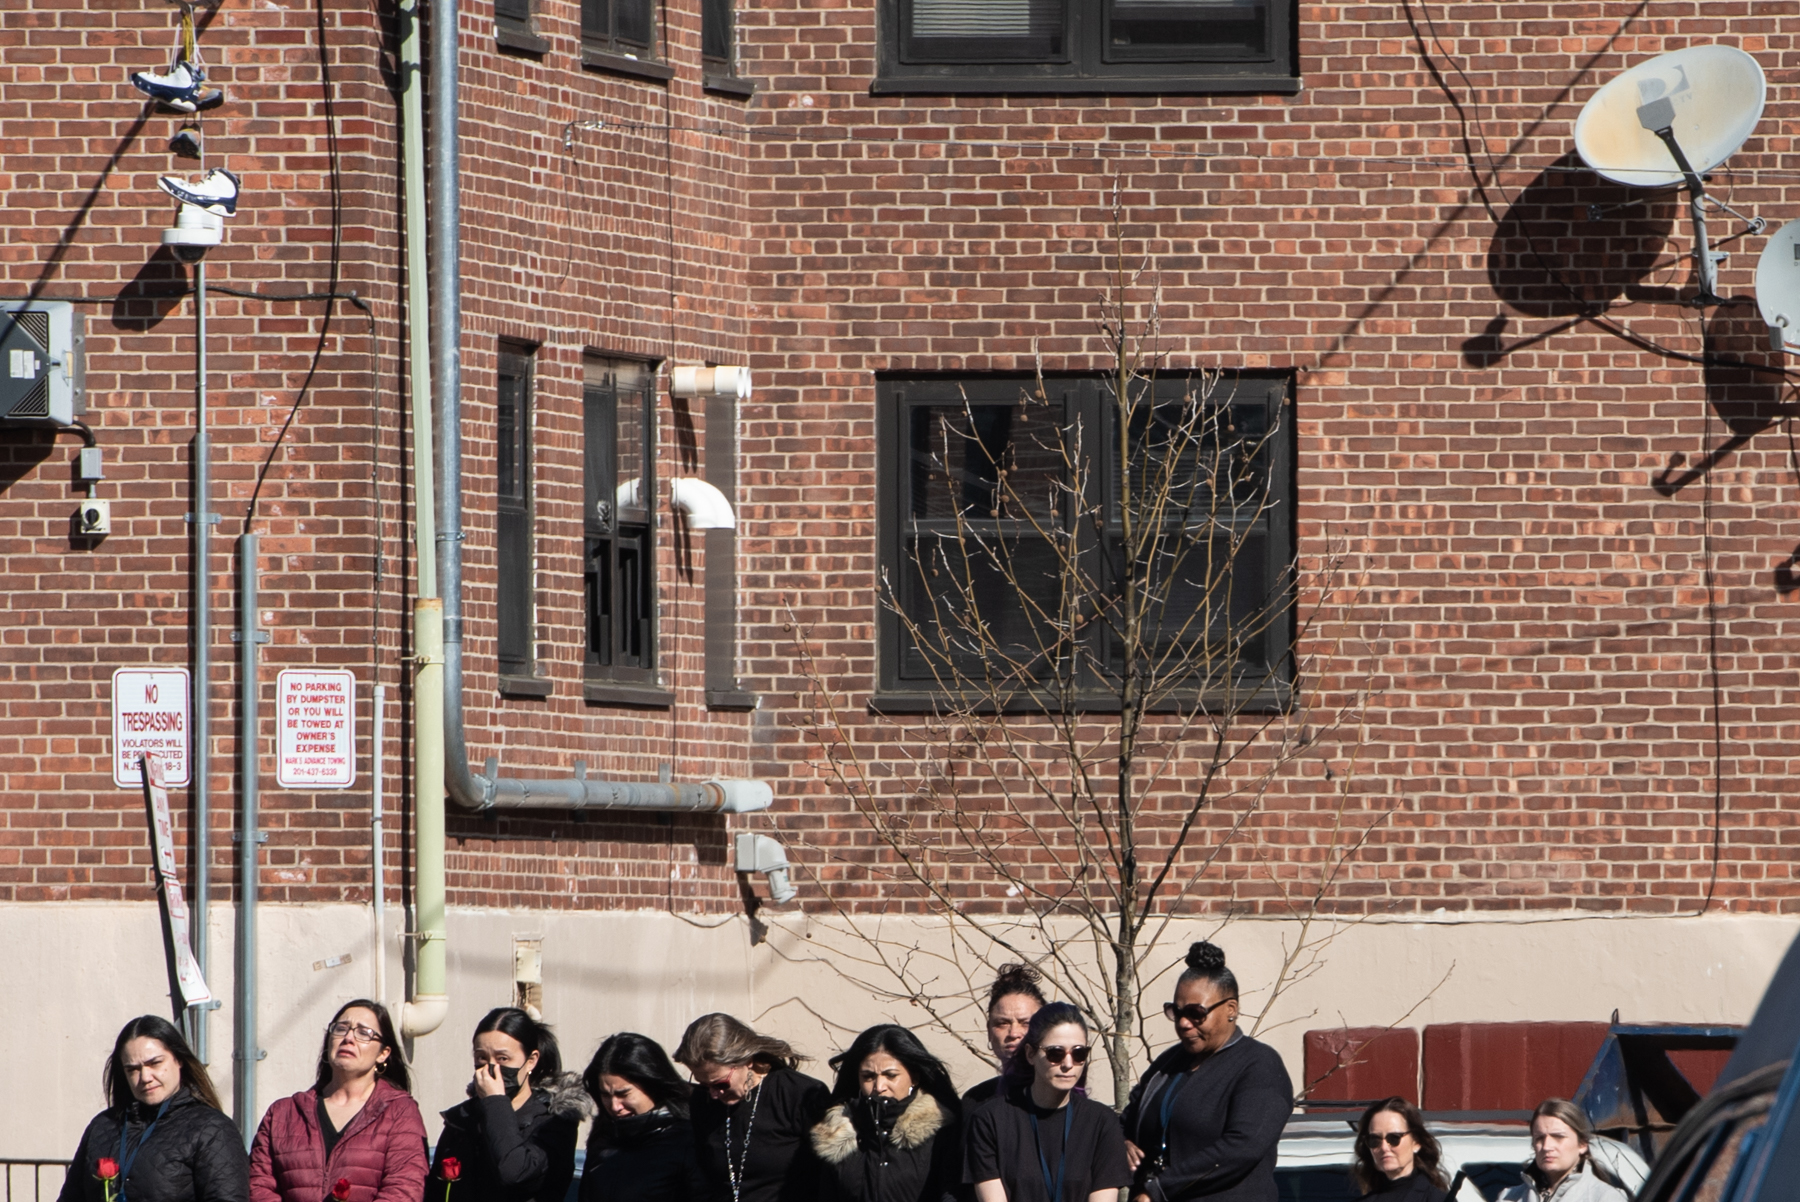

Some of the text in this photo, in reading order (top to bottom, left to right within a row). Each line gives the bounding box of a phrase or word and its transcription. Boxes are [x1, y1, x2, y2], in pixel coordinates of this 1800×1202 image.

[290, 682, 342, 692] NO PARKING
[145, 684, 158, 704] NO
[286, 695, 345, 704] BY DUMPSTER
[288, 707, 343, 716] OR YOU WILL
[122, 712, 182, 731] TRESPASSING
[287, 719, 344, 729] BE TOWED AT
[296, 732, 336, 741] OWNER'S
[121, 738, 183, 748] VIOLATORS WILL
[296, 744, 336, 753] EXPENSE
[122, 750, 131, 759] BE
